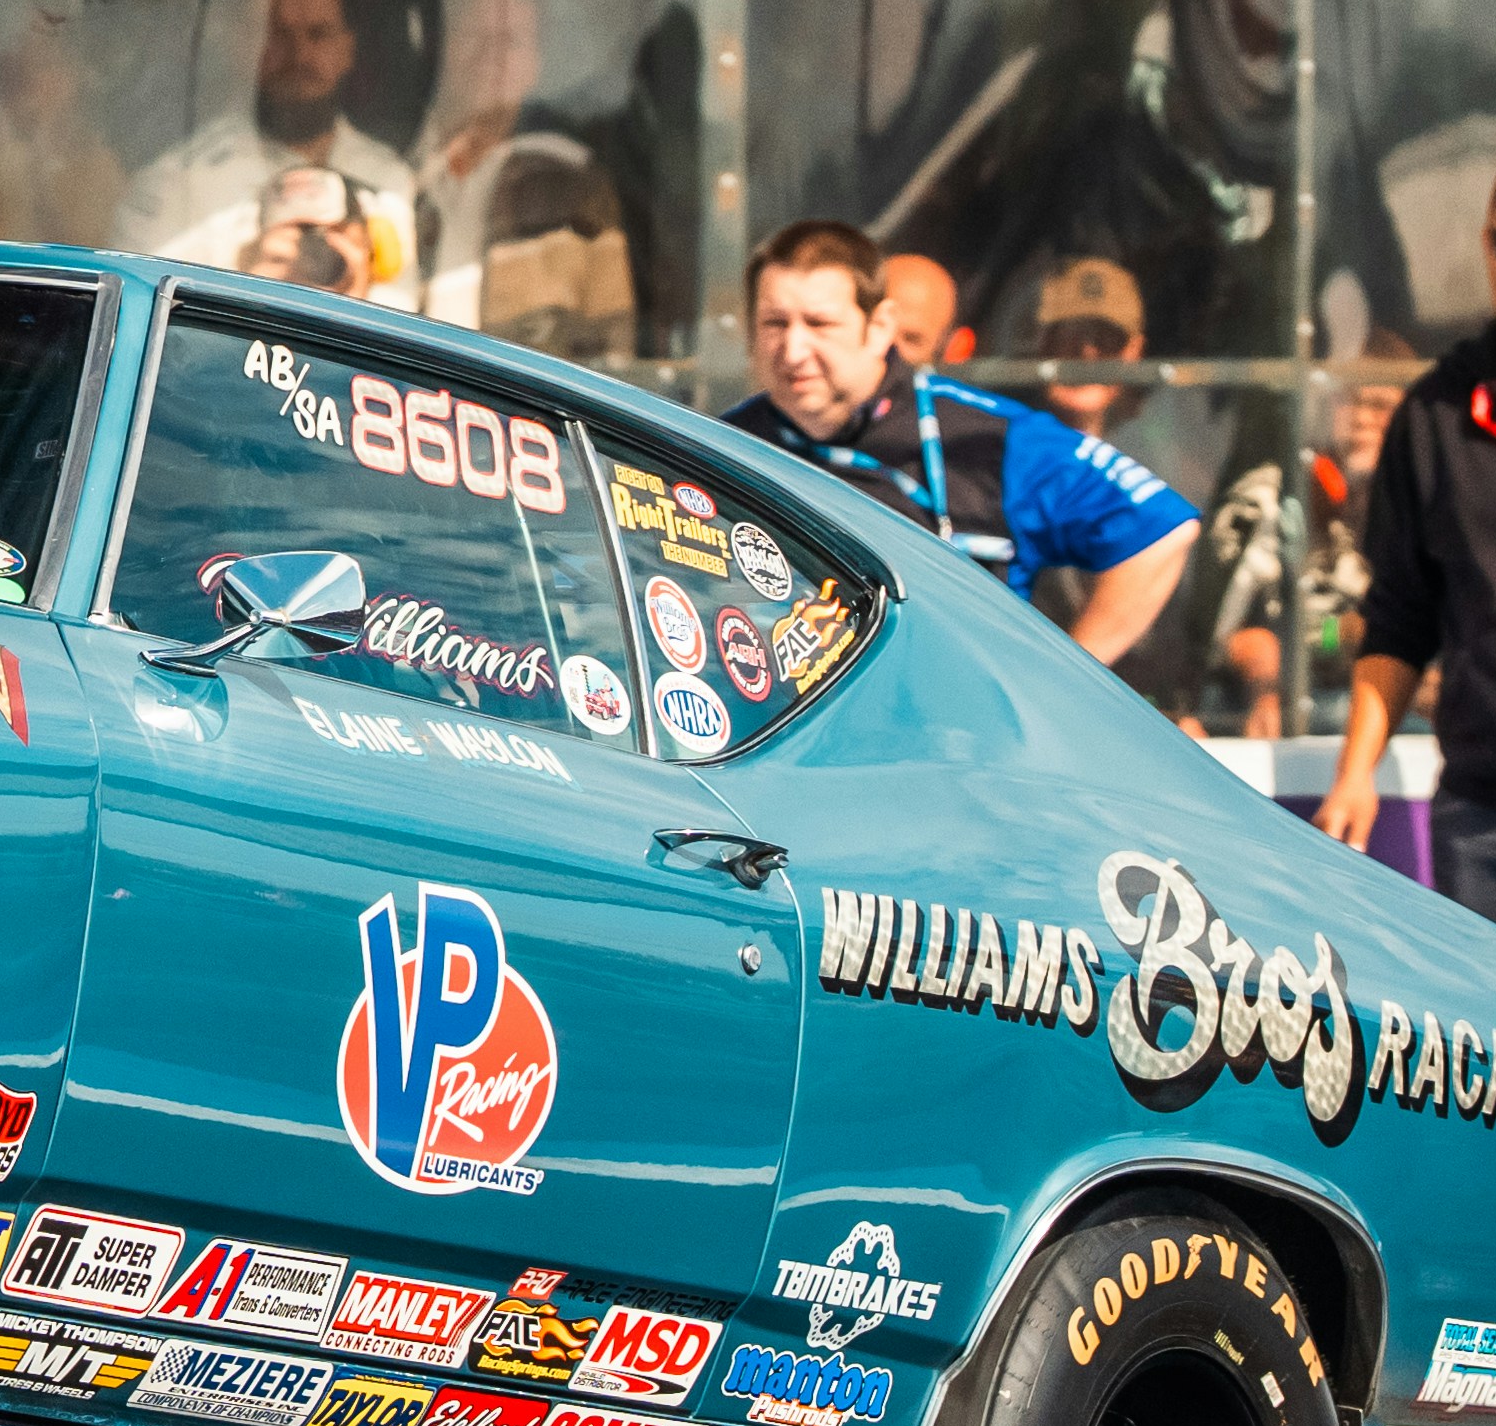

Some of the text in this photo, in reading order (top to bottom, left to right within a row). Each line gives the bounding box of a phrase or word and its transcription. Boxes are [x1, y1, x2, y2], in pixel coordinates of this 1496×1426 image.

[350, 374, 567, 514] 8608
[677, 486, 711, 514] NHRA
[666, 691, 722, 737] NHRA
[293, 696, 574, 783] ELAINE WAYLON
[819, 887, 1103, 1035] WILLIAMS
[1098, 850, 1360, 1140] Bros
[359, 882, 505, 1179] VP
[427, 1051, 552, 1148] Racing
[423, 1154, 537, 1192] LUBRICANTS
[93, 1235, 157, 1270] SUPER
[71, 1262, 153, 1298] DAMPER
[157, 1243, 256, 1321] A-1
[244, 1262, 332, 1297] PERFORMANCE
[515, 1270, 562, 1296] PRO
[232, 1290, 259, 1313] Trans
[267, 1296, 323, 1323] Converters
[337, 1278, 472, 1340] MANLEY
[1067, 1233, 1325, 1387] GOODYEAR
[63, 1324, 163, 1354] THOMPSON
[325, 1332, 456, 1365] CONNECTING RODS
[473, 1309, 542, 1352] PAC
[589, 1311, 711, 1376] MSD
[14, 1339, 116, 1384] M/T
[175, 1349, 326, 1405] MEZIERE
[476, 1354, 572, 1381] RacingSprings.com
[43, 1382, 95, 1401] WHEELS
[167, 1386, 272, 1408] ENTERPRISES
[573, 1378, 623, 1393] DISTRIBUTOR
[724, 1346, 892, 1420] manton
[136, 1392, 210, 1413] COMPONENTS
[224, 1406, 298, 1426] CHAMPIONS
